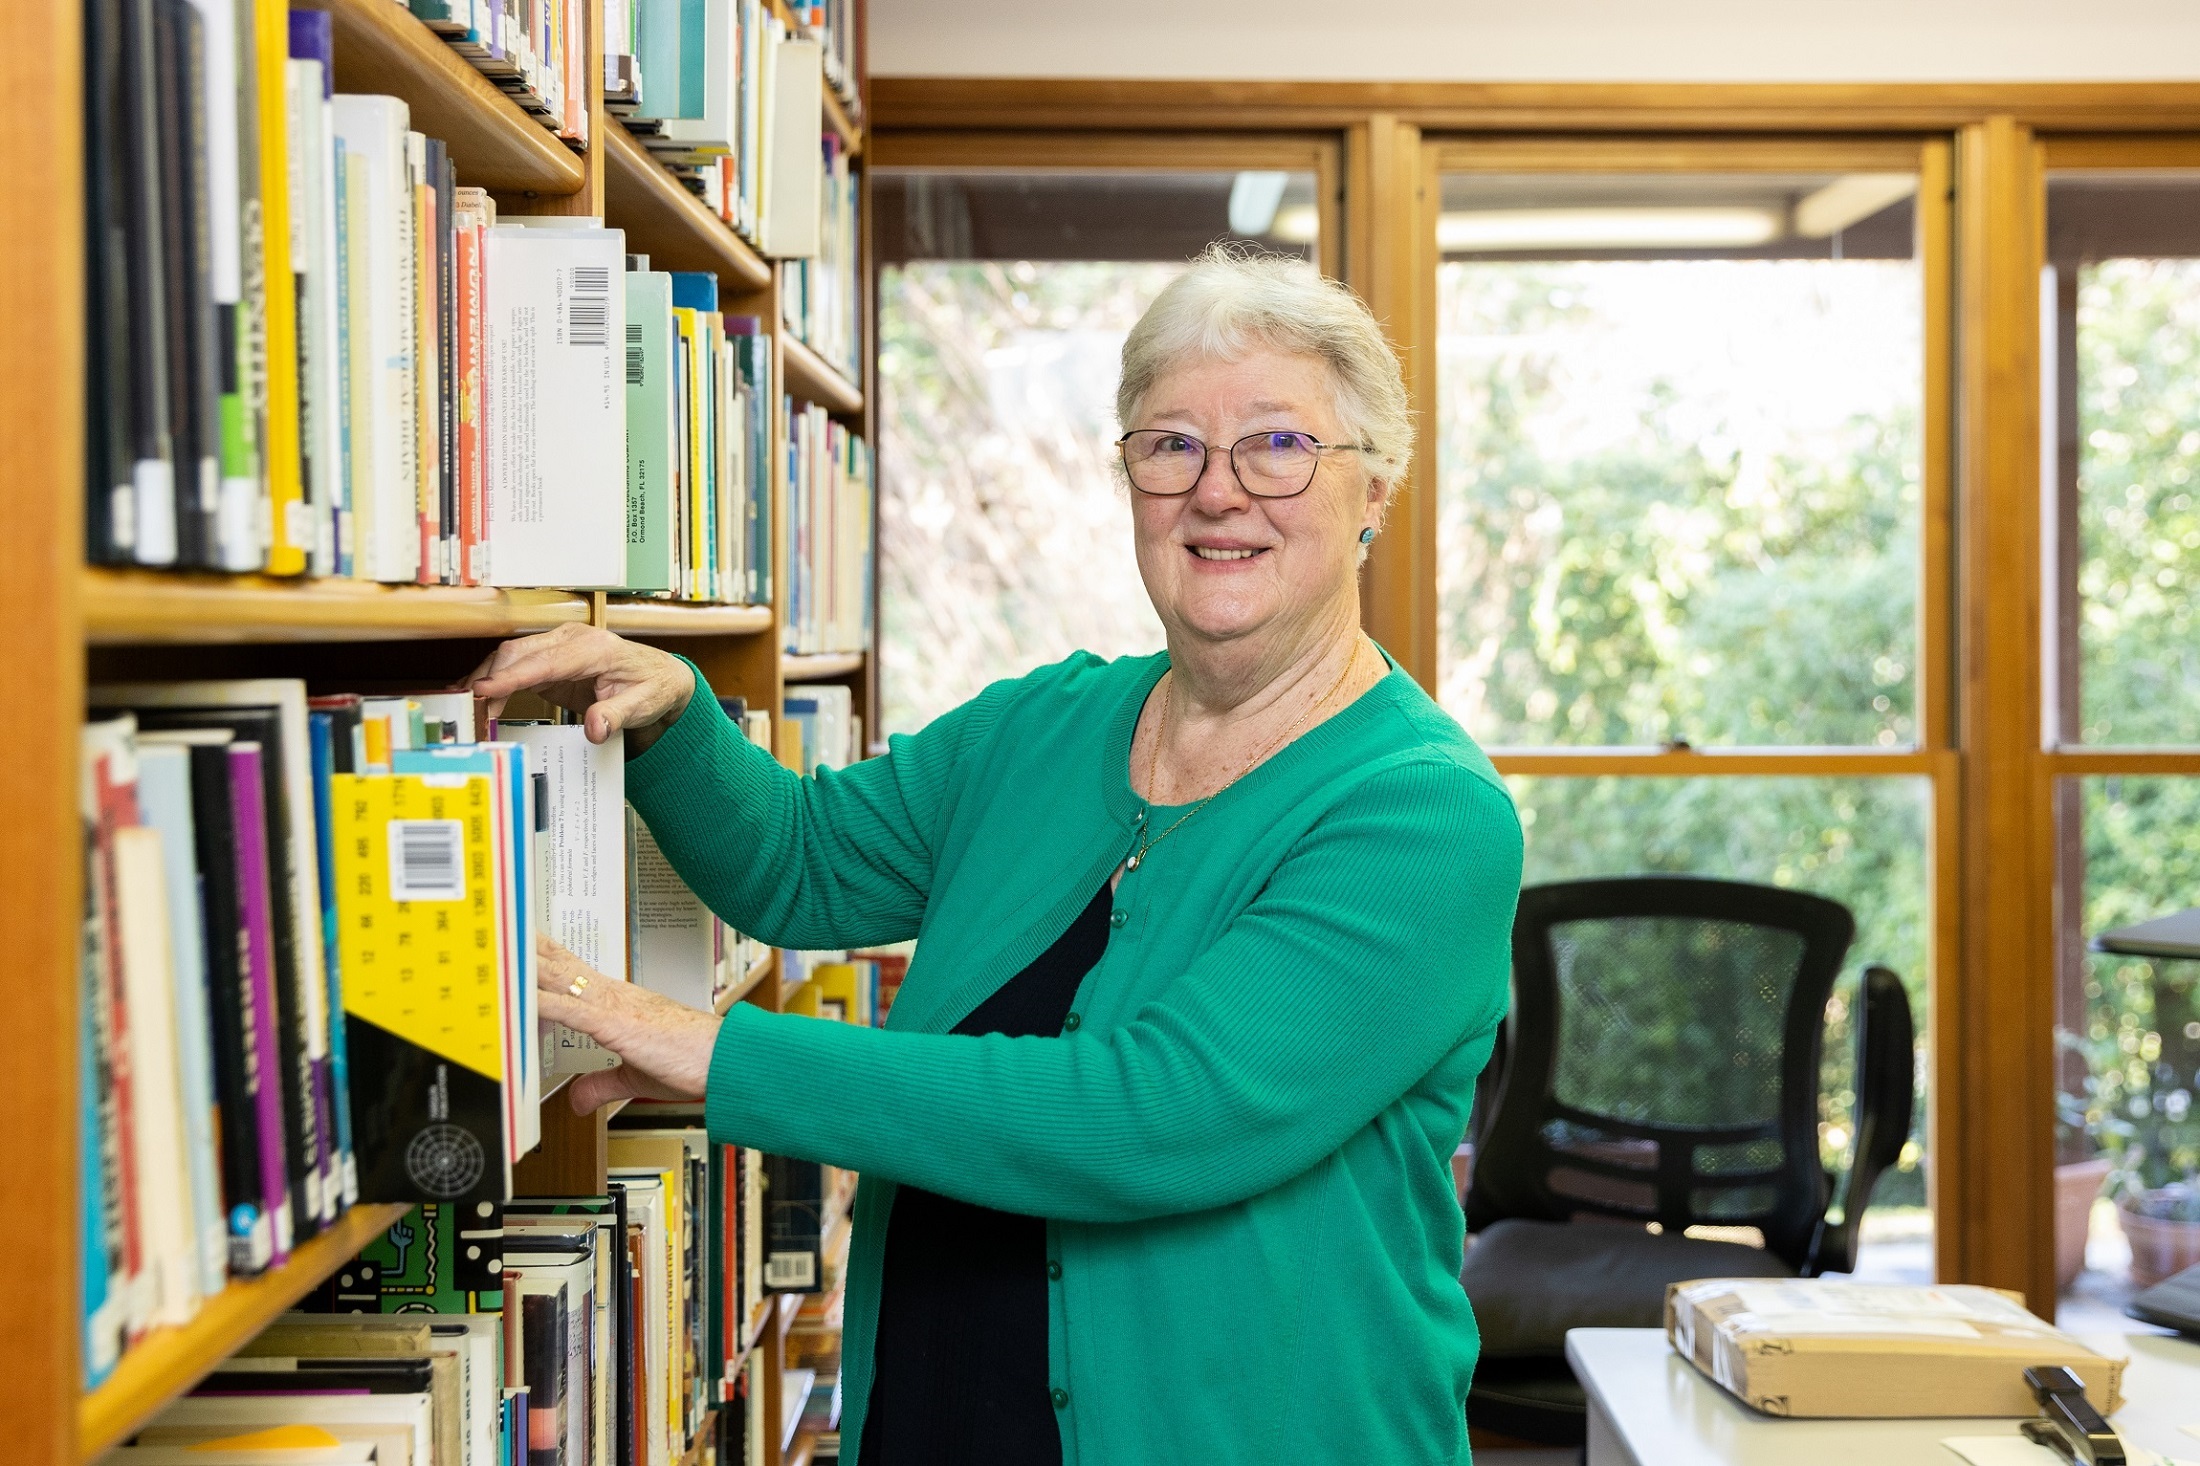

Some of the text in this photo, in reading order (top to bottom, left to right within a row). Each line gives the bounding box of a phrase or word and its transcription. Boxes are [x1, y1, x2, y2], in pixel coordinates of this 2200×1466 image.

[468, 247, 479, 429] NUMERICON
[502, 355, 508, 364] OF
[603, 370, 610, 379] IN
[400, 419, 410, 482] BRAIN
[639, 481, 645, 490] FL
[362, 950, 375, 964] 12
[399, 931, 414, 982] 13 78
[440, 986, 453, 999] 14
[478, 1003, 491, 1016] 15
[607, 1057, 614, 1068] 32
[465, 1429, 471, 1447] OF
